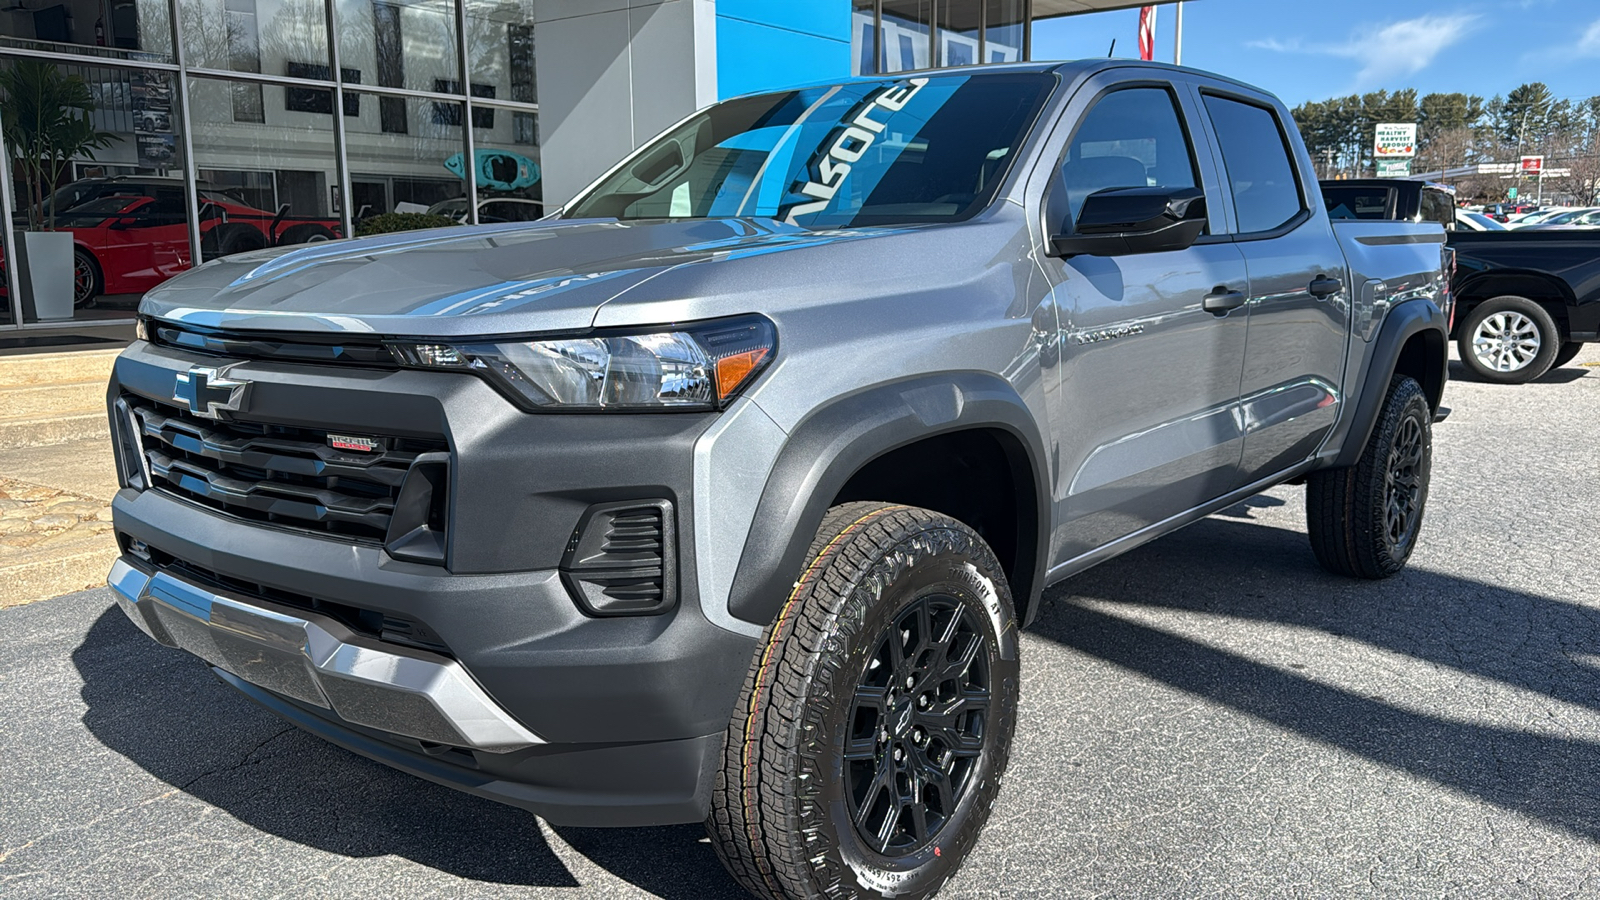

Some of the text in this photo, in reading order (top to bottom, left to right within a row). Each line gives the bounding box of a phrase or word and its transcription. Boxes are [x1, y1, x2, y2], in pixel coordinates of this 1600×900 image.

[327, 434, 378, 448] TRAIL
[332, 441, 372, 452] BOSS
[990, 602, 1001, 615] AT
